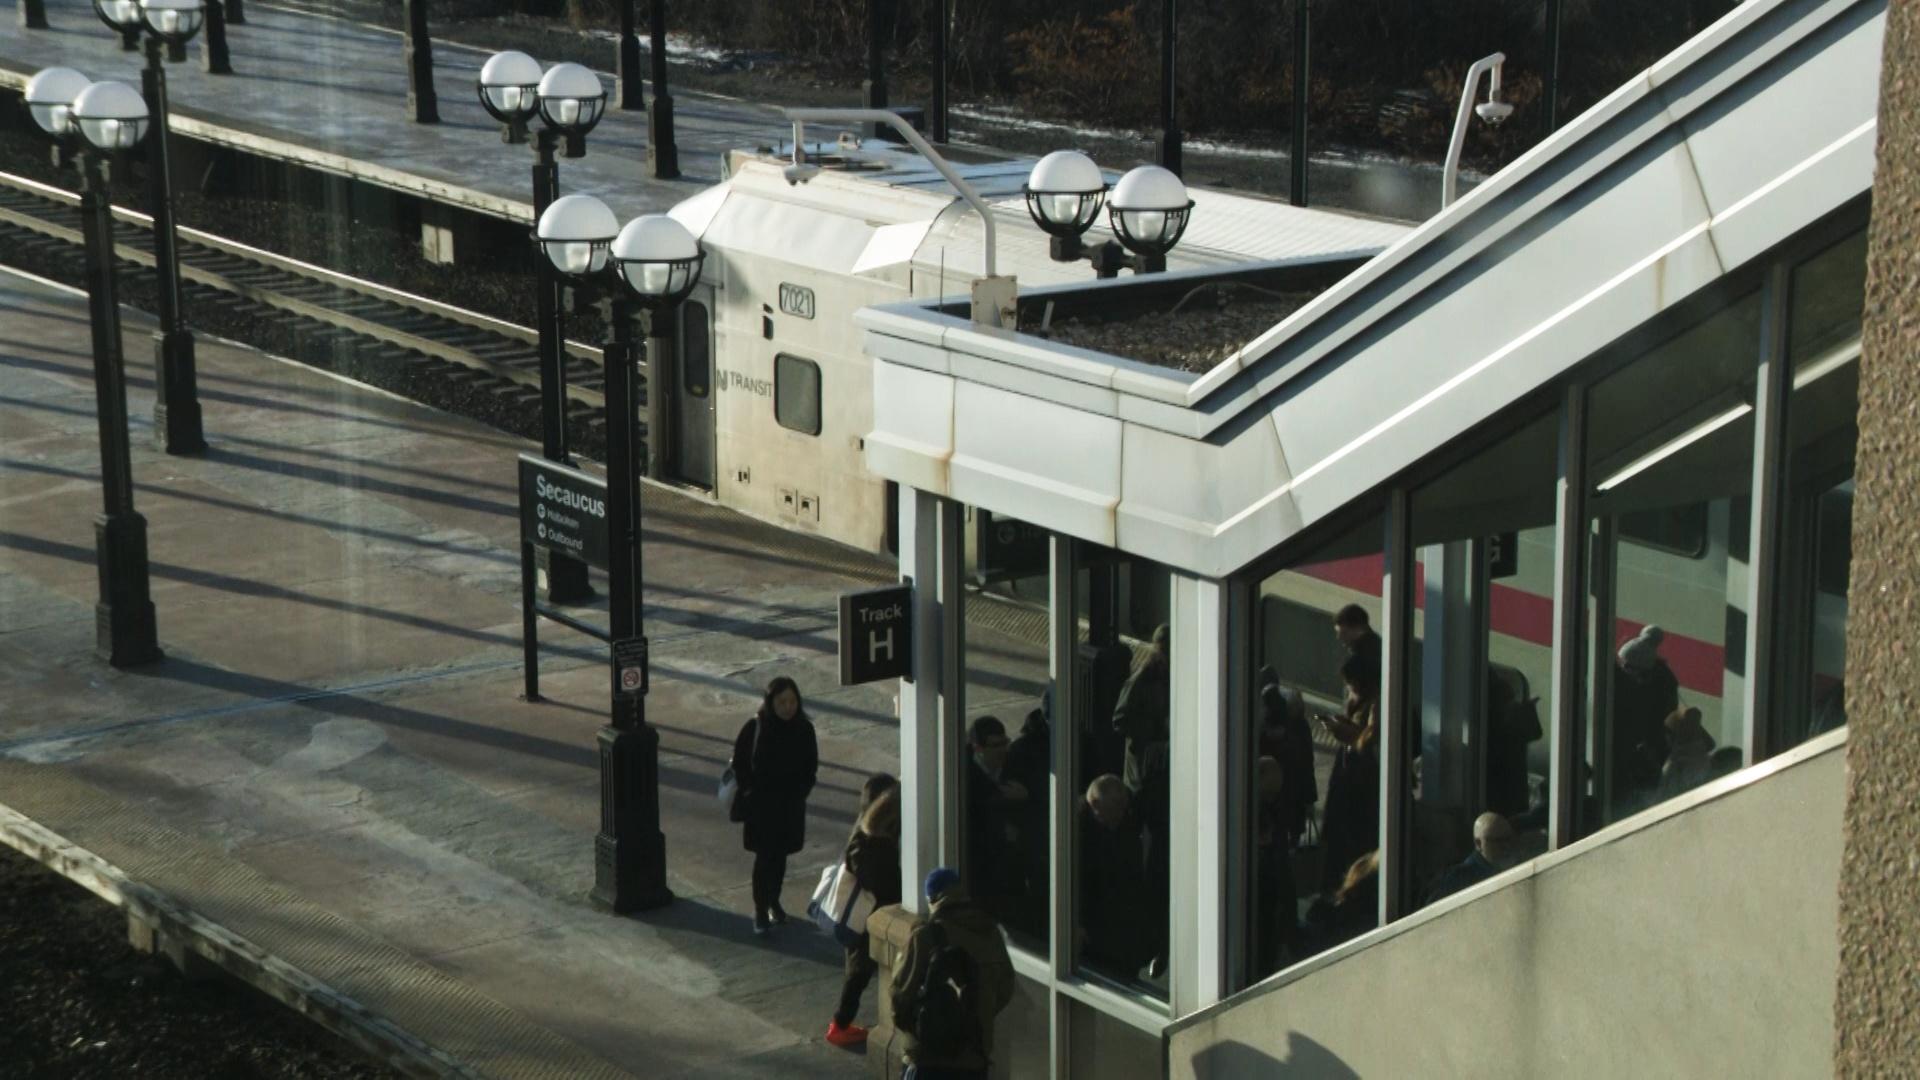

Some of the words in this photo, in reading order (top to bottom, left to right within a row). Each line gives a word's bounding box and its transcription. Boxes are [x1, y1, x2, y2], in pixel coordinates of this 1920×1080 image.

[782, 286, 811, 315] 7021
[729, 371, 773, 397] TRANSIT
[536, 474, 605, 518] Secaucus
[860, 603, 903, 623] Track
[869, 627, 893, 663] H
